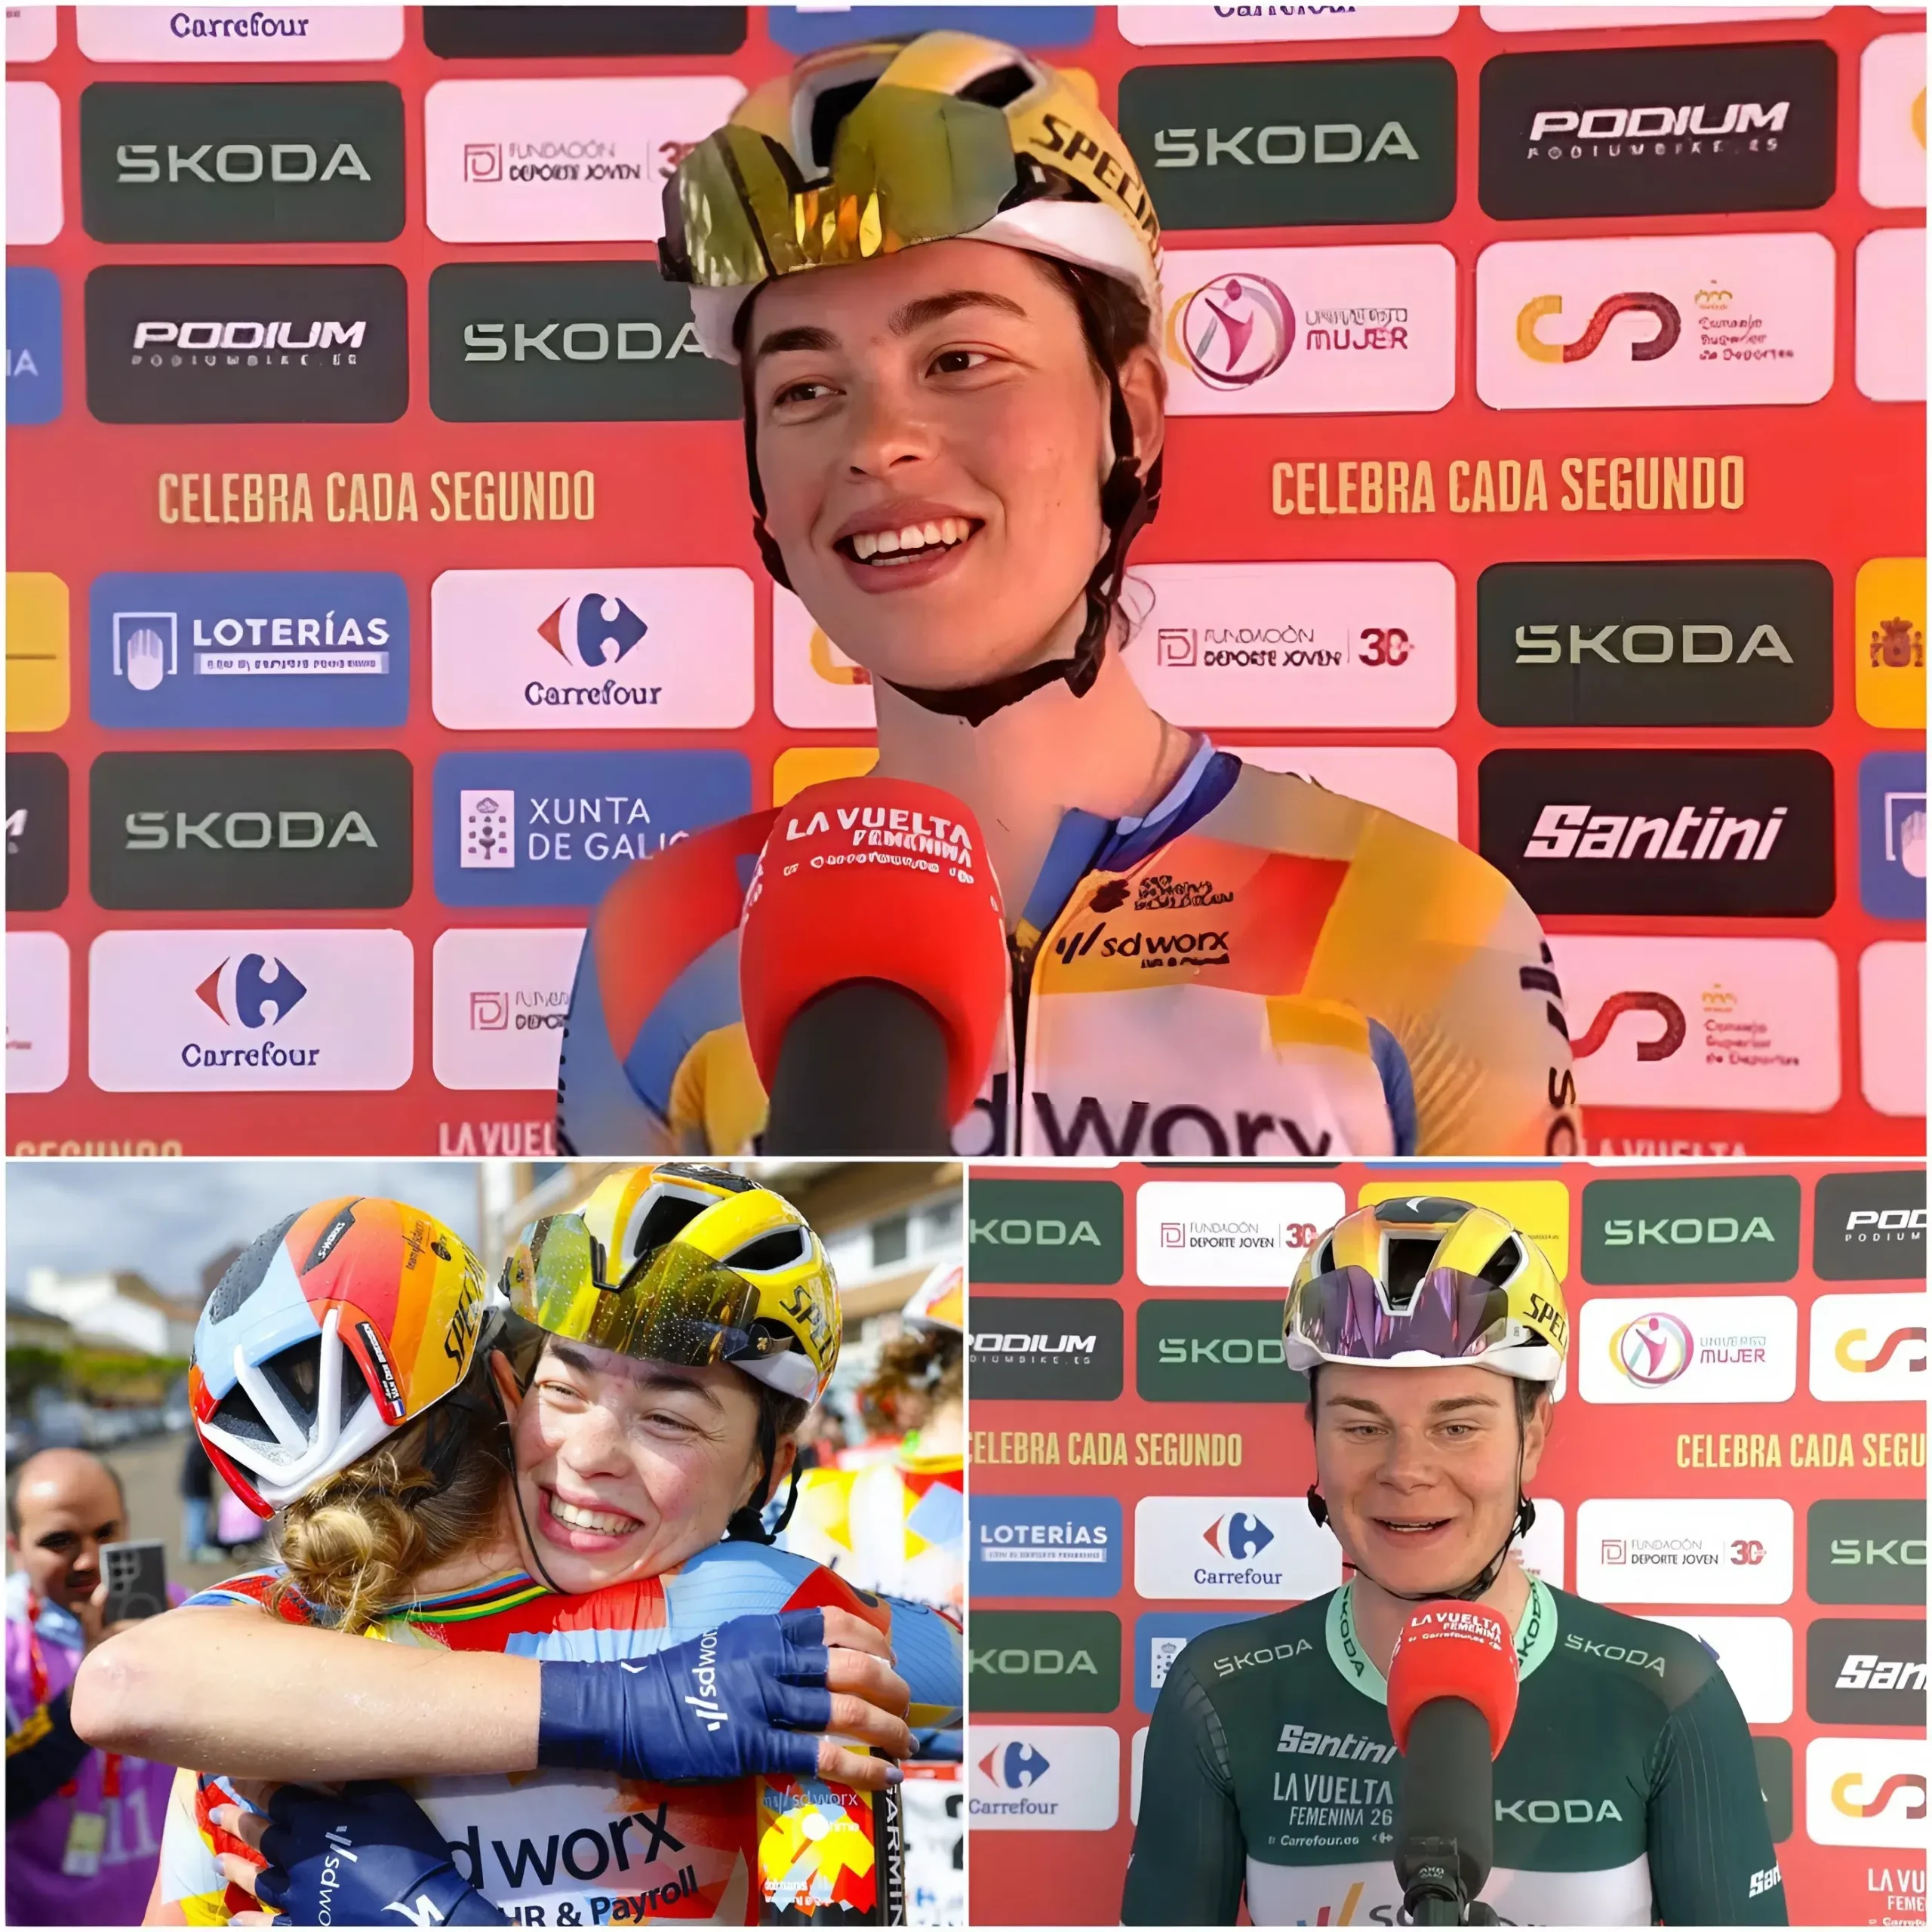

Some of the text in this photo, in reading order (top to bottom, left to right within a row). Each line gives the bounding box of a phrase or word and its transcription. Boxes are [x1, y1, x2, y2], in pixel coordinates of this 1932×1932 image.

[170, 13, 309, 38] Carrefour
[1530, 102, 1790, 141] PODIUM
[1155, 122, 1420, 168] SKODA
[115, 143, 371, 183] SKODA
[133, 321, 367, 349] PODIUM
[1306, 327, 1408, 351] MUJER
[158, 470, 595, 524] CELEBRA CADA SEGUNDO
[1272, 456, 1745, 515] CELEBRA CADA SEGUNDO
[193, 611, 390, 647] LOTERÍAS
[1515, 624, 1795, 664] SKODA
[525, 680, 662, 706] Carrefour
[529, 797, 651, 825] XUNTA
[125, 810, 379, 850] SKODA
[786, 807, 973, 851] LA VUELTA
[1524, 804, 1788, 860] Santini
[529, 834, 572, 861] DE
[182, 1041, 320, 1068] Carrefour
[438, 1121, 478, 1155] LA
[969, 1219, 1102, 1246] KODA
[1239, 1237, 1275, 1247] JOVEN
[1604, 1217, 1776, 1245] SKODA
[1700, 1349, 1766, 1364] MUJER
[1068, 1432, 1128, 1466] CADA
[1135, 1432, 1242, 1466] SEGUNDO
[1676, 1433, 1926, 1468] CELEBRA CADA SEGU
[980, 1521, 1108, 1545] LOTERÍAS
[1682, 1554, 1718, 1564] JOVEN
[1194, 1568, 1283, 1586] Carrefour
[1411, 1612, 1502, 1636] LA VUELTA
[969, 1649, 1099, 1675] KODA
[1214, 1638, 1313, 1677] SKODA
[1564, 1633, 1666, 1677] SKODA
[1835, 1654, 1927, 1690] San
[1276, 1724, 1398, 1764] Santini
[1273, 1772, 1394, 1804] LA VUELTA
[969, 1798, 1059, 1815] Carrefour
[1289, 1806, 1393, 1826] FEMENINA 26
[1494, 1799, 1623, 1824] KODA
[1749, 1860, 1782, 1898] San
[1868, 1868, 1925, 1894] LA VU
[555, 1902, 583, 1926] &
[590, 1864, 698, 1925] Payroll
